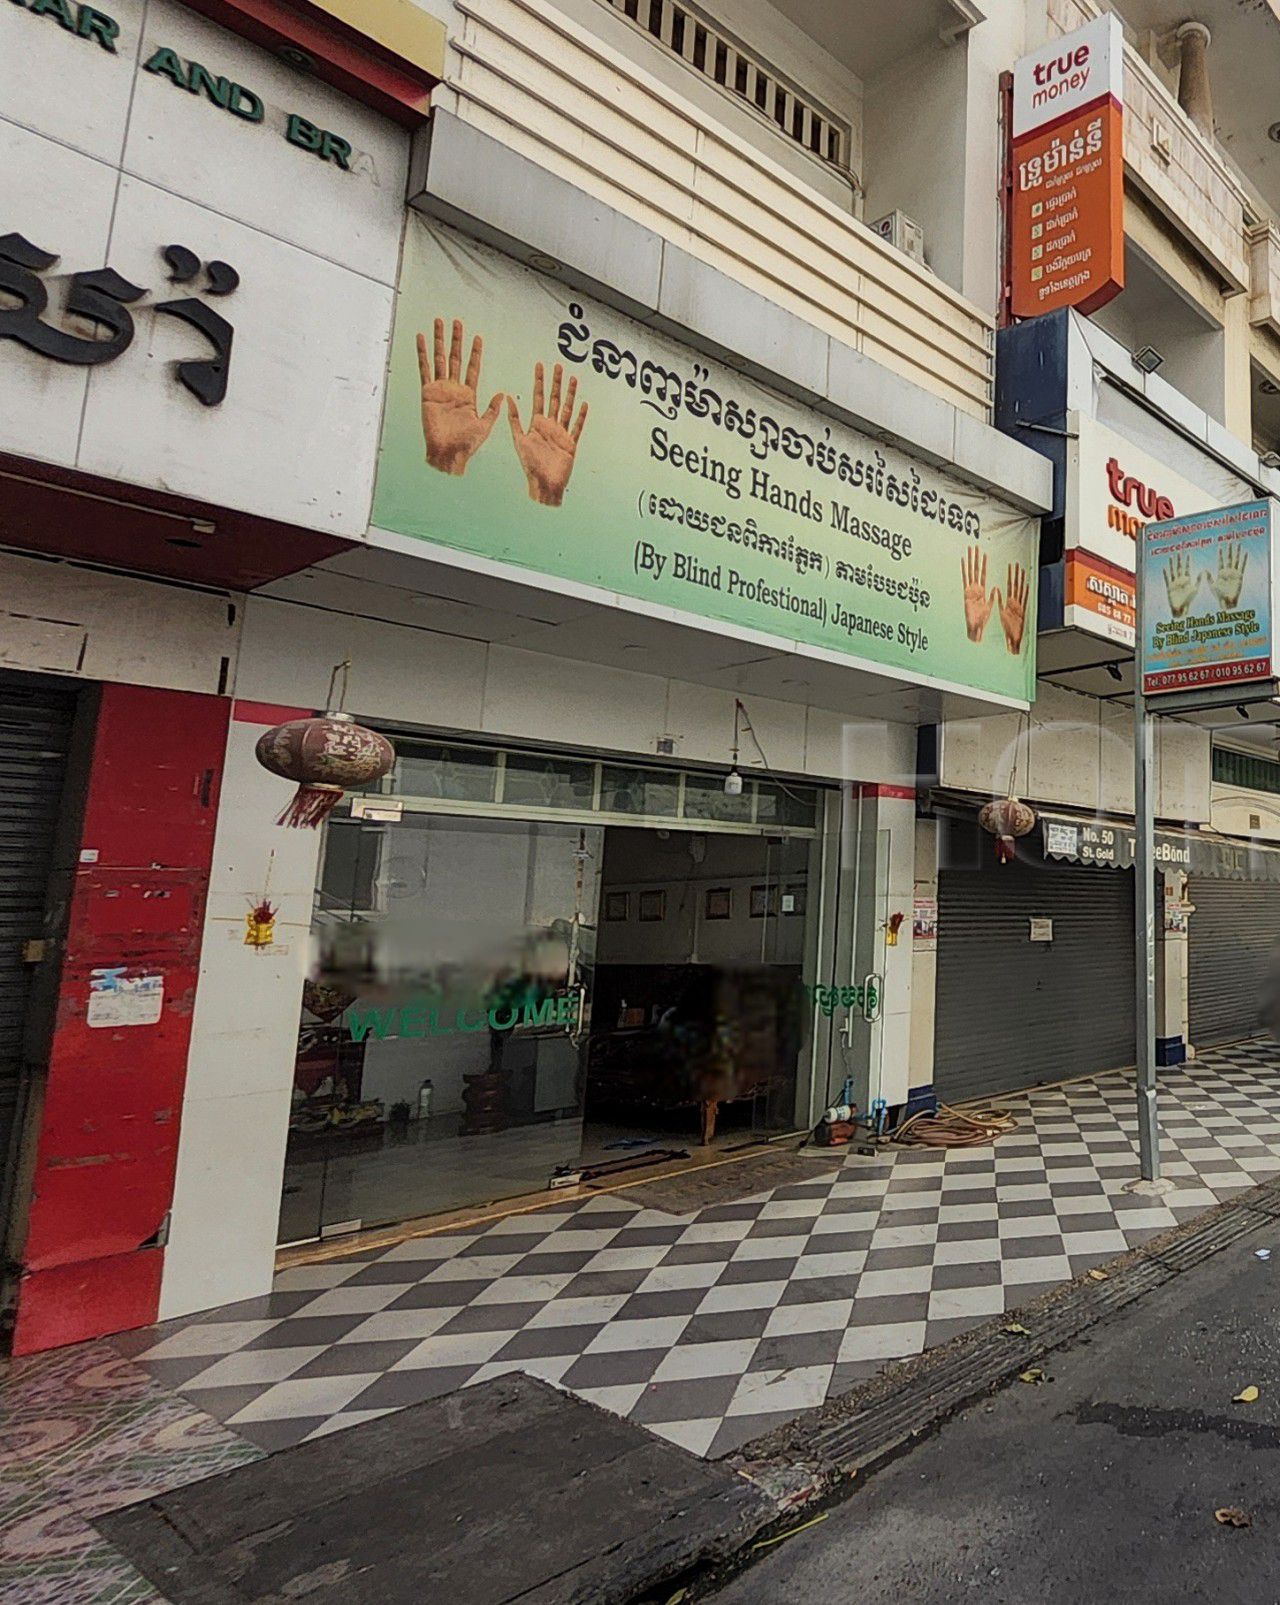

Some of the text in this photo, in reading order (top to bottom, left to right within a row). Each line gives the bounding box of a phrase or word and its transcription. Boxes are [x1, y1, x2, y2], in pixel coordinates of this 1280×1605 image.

[7, 0, 119, 55] AR
[142, 47, 264, 124] AND
[1033, 45, 1090, 86] true
[1032, 67, 1090, 109] money
[650, 426, 912, 561] Seeing Hands Massage
[1106, 457, 1175, 521] true
[634, 540, 929, 654] (By Blind Profestional) Japanese Style
[1152, 636, 1165, 650] By
[1166, 631, 1189, 646] Blind
[1191, 625, 1233, 643] Japanese
[1235, 621, 1260, 637] Style
[1156, 609, 1256, 635] Seeing Hands Massage
[1162, 675, 1176, 685] 077
[1178, 673, 1187, 683] 95
[1215, 667, 1231, 678] 010
[1232, 666, 1242, 676] 95
[1244, 664, 1254, 674] 62
[1256, 662, 1267, 672] 67
[1082, 827, 1100, 843] No.
[1101, 830, 1115, 846] 50
[1095, 848, 1115, 861] Gold
[343, 996, 580, 1042] WELCOME
